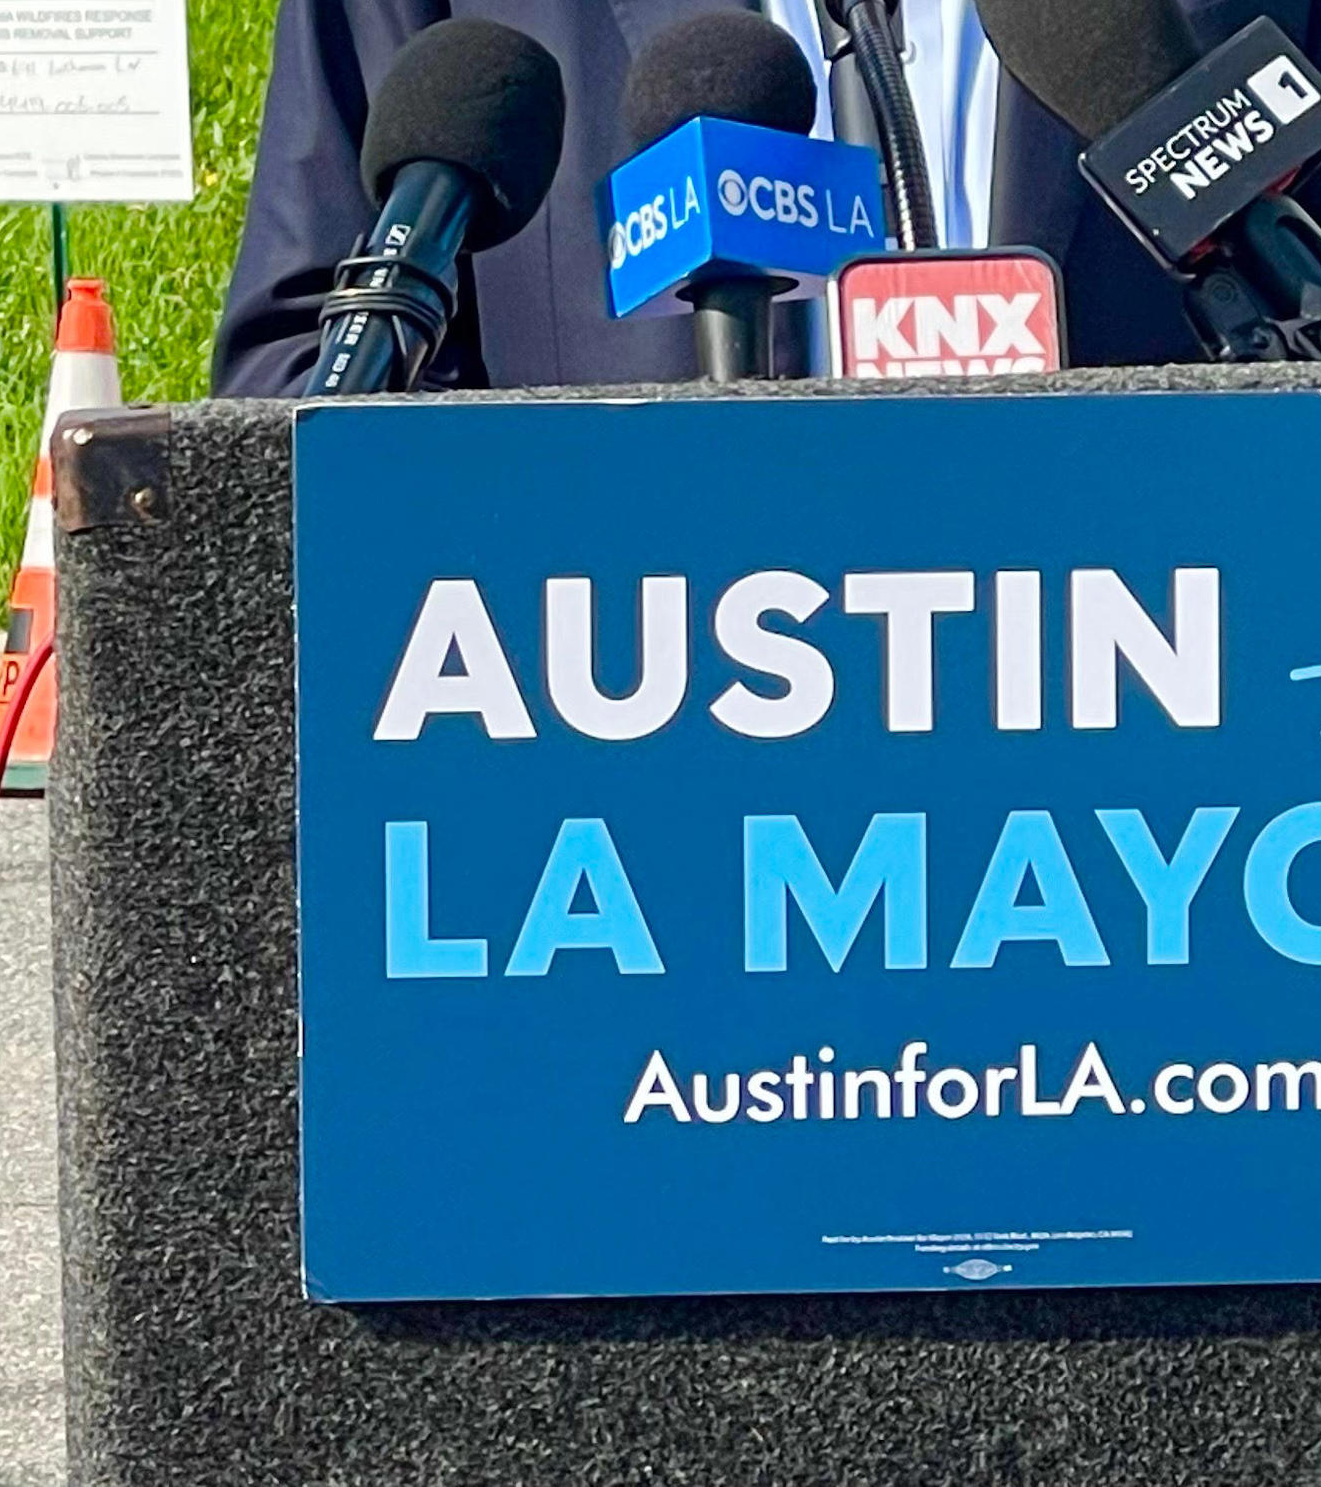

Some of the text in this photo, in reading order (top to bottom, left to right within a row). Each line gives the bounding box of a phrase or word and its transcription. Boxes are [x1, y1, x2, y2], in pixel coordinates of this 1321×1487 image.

[13, 28, 72, 40] REMOVAL
[74, 27, 132, 40] SUPPORT
[16, 10, 82, 23] WILDFIRES
[85, 9, 153, 23] RESPONSE
[1125, 88, 1252, 194] SPECTRUM
[1170, 71, 1308, 200] NEWS 1
[627, 175, 701, 257] CBS LA
[748, 176, 875, 238] CBS LA
[852, 292, 1045, 361] KNX
[374, 567, 1220, 741] AUSTIN
[384, 817, 666, 979] LA
